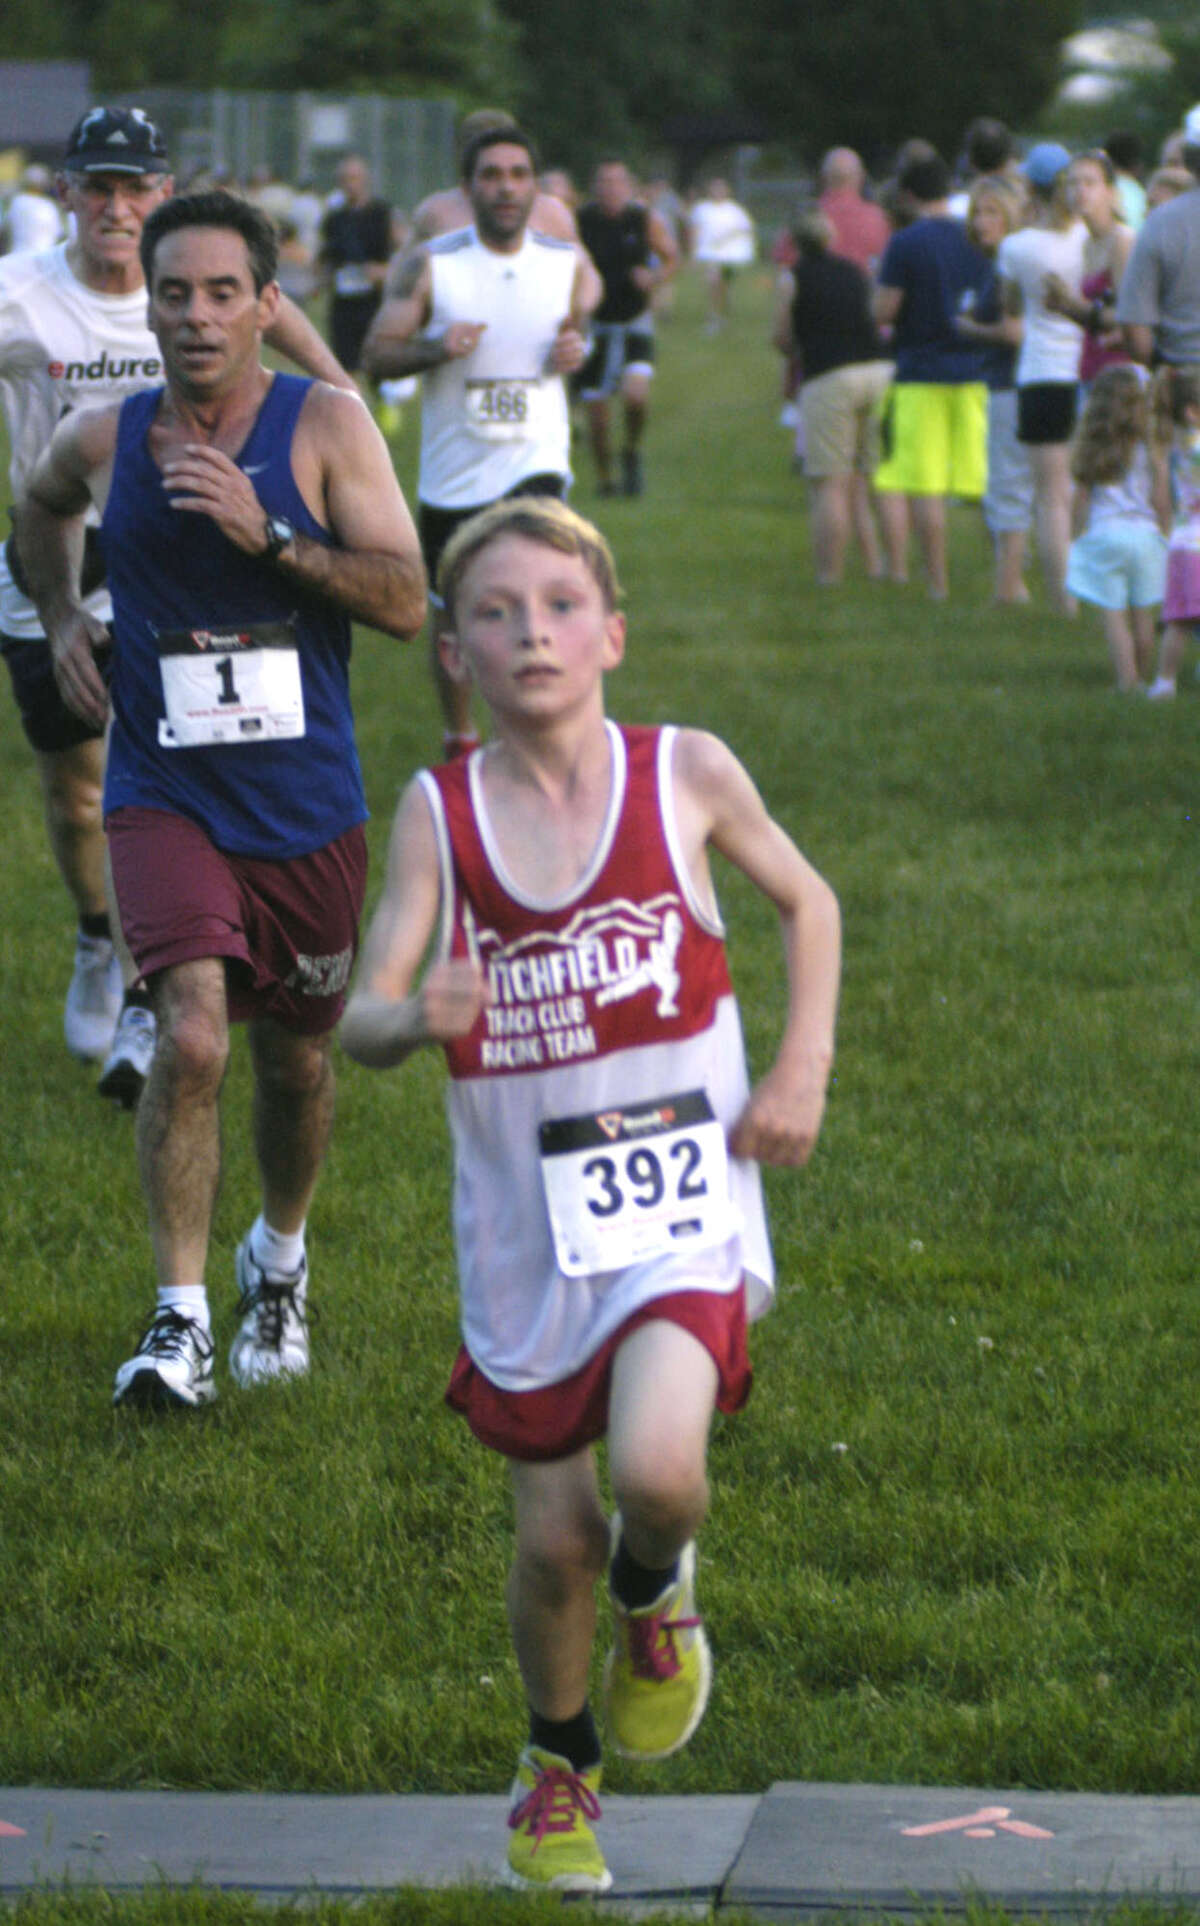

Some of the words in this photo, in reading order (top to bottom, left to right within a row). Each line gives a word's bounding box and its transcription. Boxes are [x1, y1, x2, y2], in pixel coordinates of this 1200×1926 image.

[215, 656, 241, 705] 1
[487, 935, 639, 1004] ITCHFIELD
[544, 1025, 597, 1060] TEAM
[582, 1138, 708, 1218] 392
